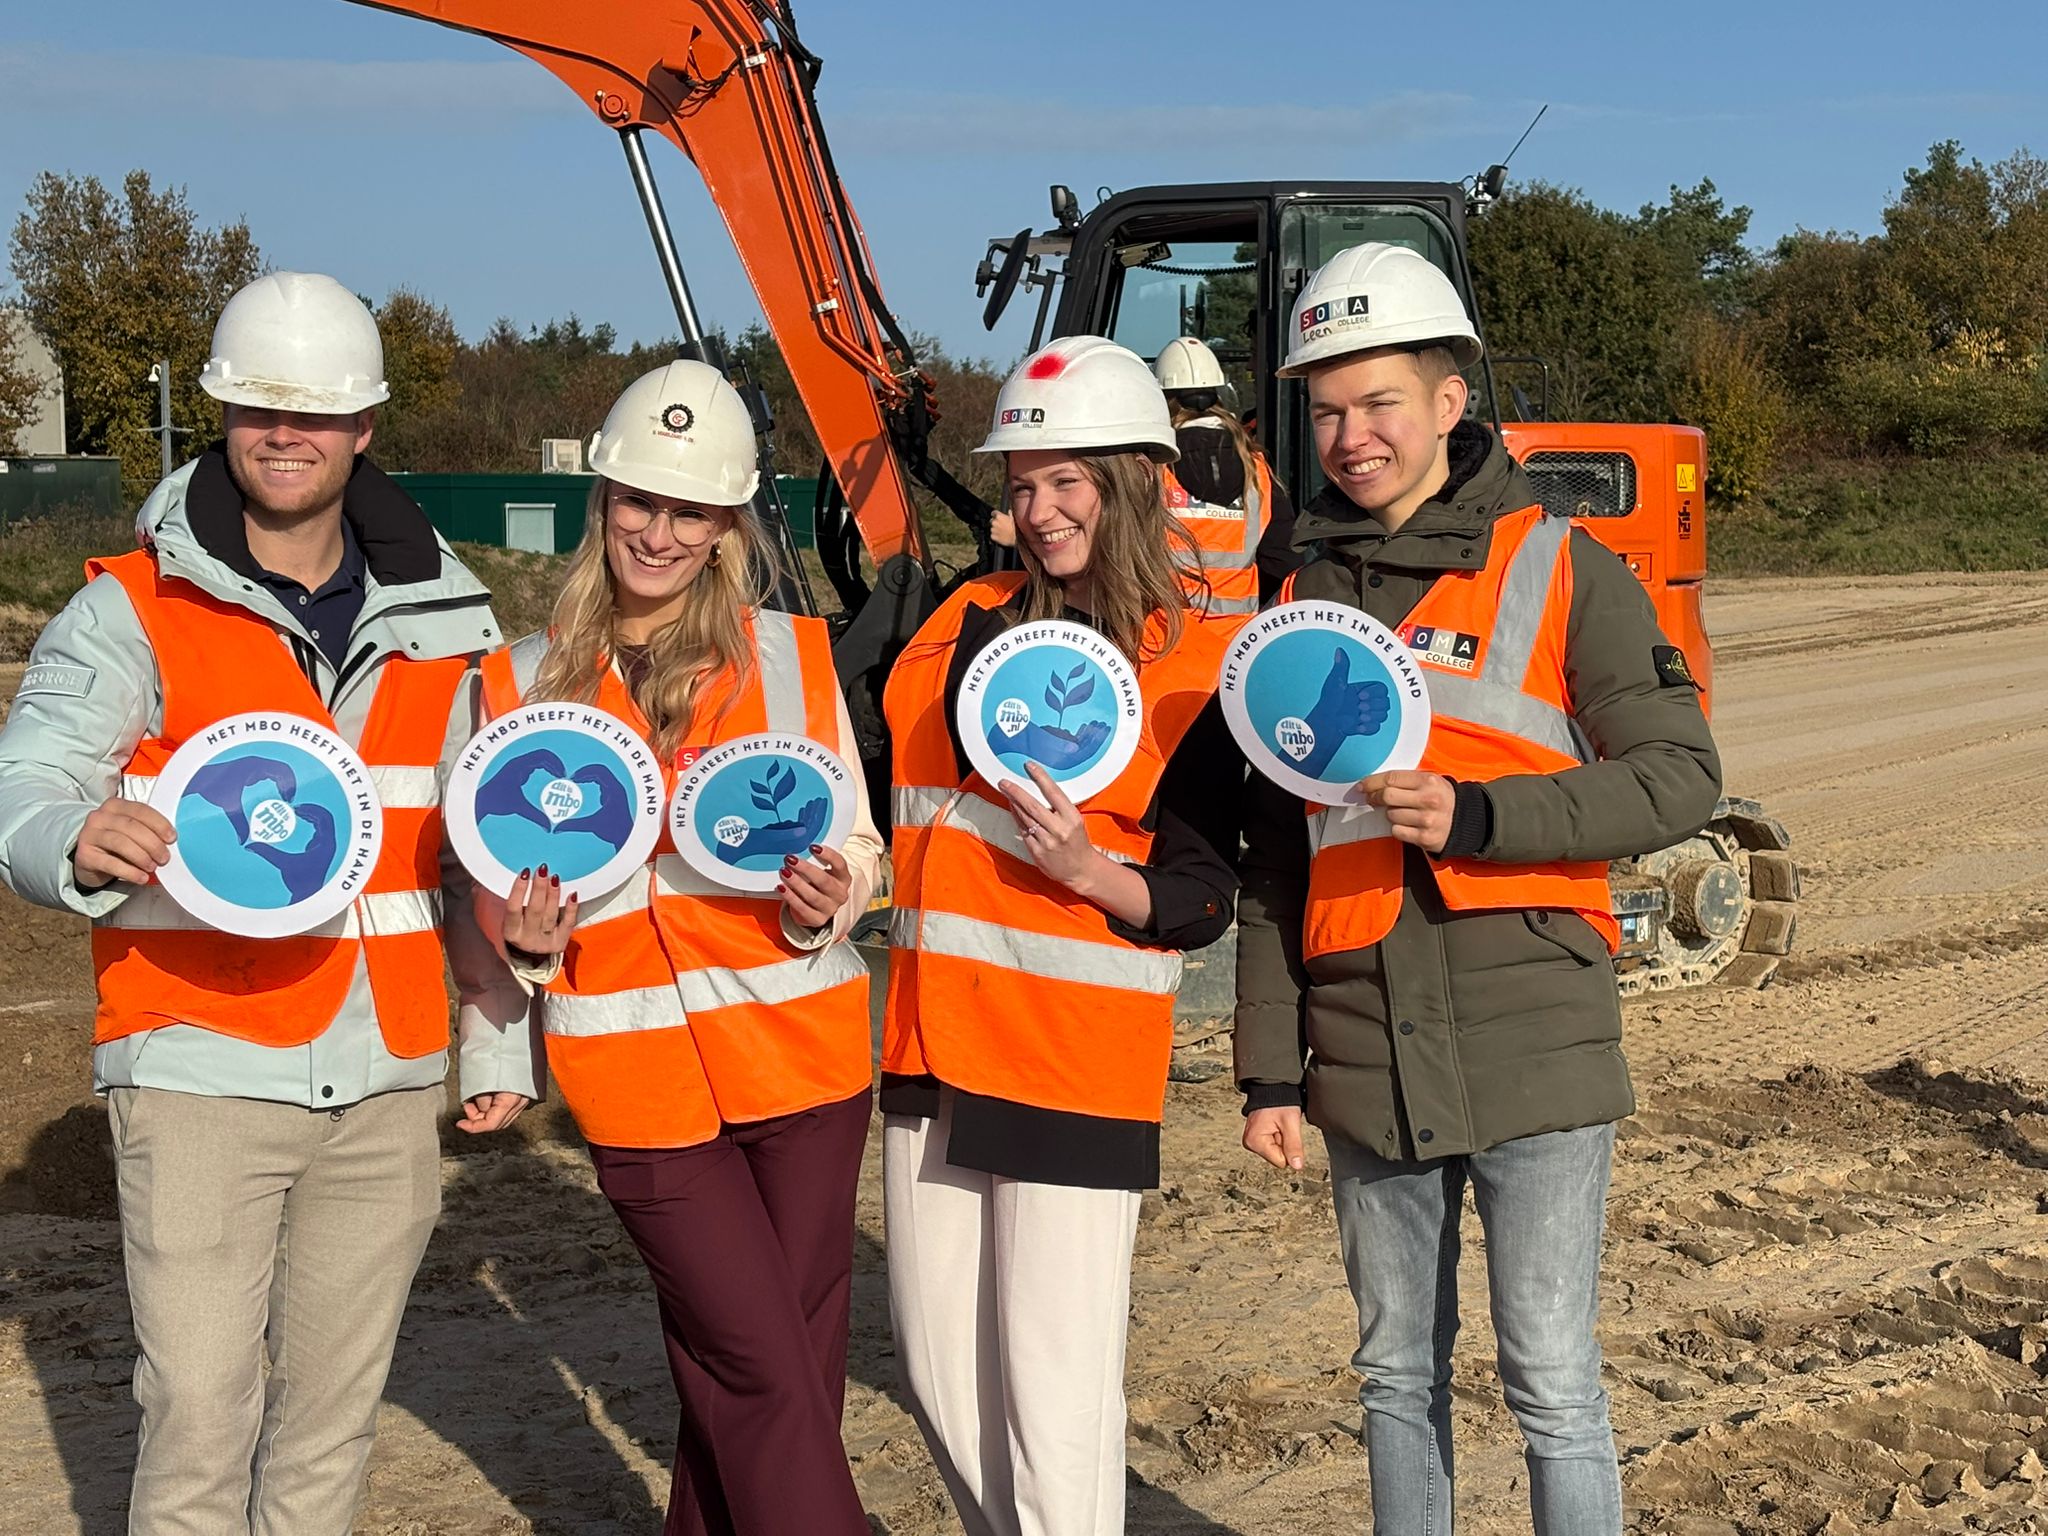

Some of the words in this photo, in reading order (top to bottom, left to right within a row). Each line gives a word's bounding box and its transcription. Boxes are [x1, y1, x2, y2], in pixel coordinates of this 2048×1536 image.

[1302, 297, 1366, 328] SOMA
[1337, 316, 1370, 327] COLLEGE
[1302, 327, 1332, 343] Leen
[1002, 409, 1042, 423] SOMA
[1225, 665, 1238, 692] HET
[1234, 633, 1258, 661] MBO
[1261, 611, 1307, 634] HEEFT
[1314, 610, 1345, 625] HET
[1351, 619, 1370, 636] IN
[1374, 634, 1394, 653] DE
[1394, 655, 1422, 699] HAND
[1425, 652, 1473, 670] COLLEGE
[967, 667, 985, 692] HET
[984, 642, 1010, 666] MBO
[1014, 629, 1056, 645] HEEFT
[1062, 631, 1088, 646] HET
[1090, 643, 1107, 658] IN
[1107, 658, 1123, 676] DE
[1119, 679, 1136, 717] HAND
[999, 709, 1029, 723] mbo
[206, 725, 236, 745] HET
[245, 720, 282, 732] MBO
[1007, 722, 1021, 733] .nl
[289, 725, 338, 755] HEEFT
[743, 740, 769, 752] HET
[775, 740, 792, 750] IN
[1280, 730, 1314, 746] mbo
[797, 744, 813, 757] DE
[1294, 745, 1308, 756] .nl
[463, 745, 485, 772] HET
[486, 720, 519, 744] MBO
[526, 710, 576, 725] HEEFT
[582, 714, 612, 733] HET
[613, 731, 632, 748] IN
[631, 750, 648, 769] DE
[642, 773, 657, 815] HAND
[699, 747, 737, 774] HEEFT
[816, 753, 844, 782] HAND
[338, 758, 362, 785] HET
[680, 776, 699, 802] MBO
[357, 791, 371, 811] IN
[544, 791, 582, 809] mbo
[552, 808, 570, 818] .nl
[676, 806, 687, 828] HET
[255, 806, 288, 839] mbo
[361, 820, 373, 840] DE
[718, 823, 749, 840] mbo
[254, 828, 273, 840] .nl
[341, 848, 369, 891] HAND
